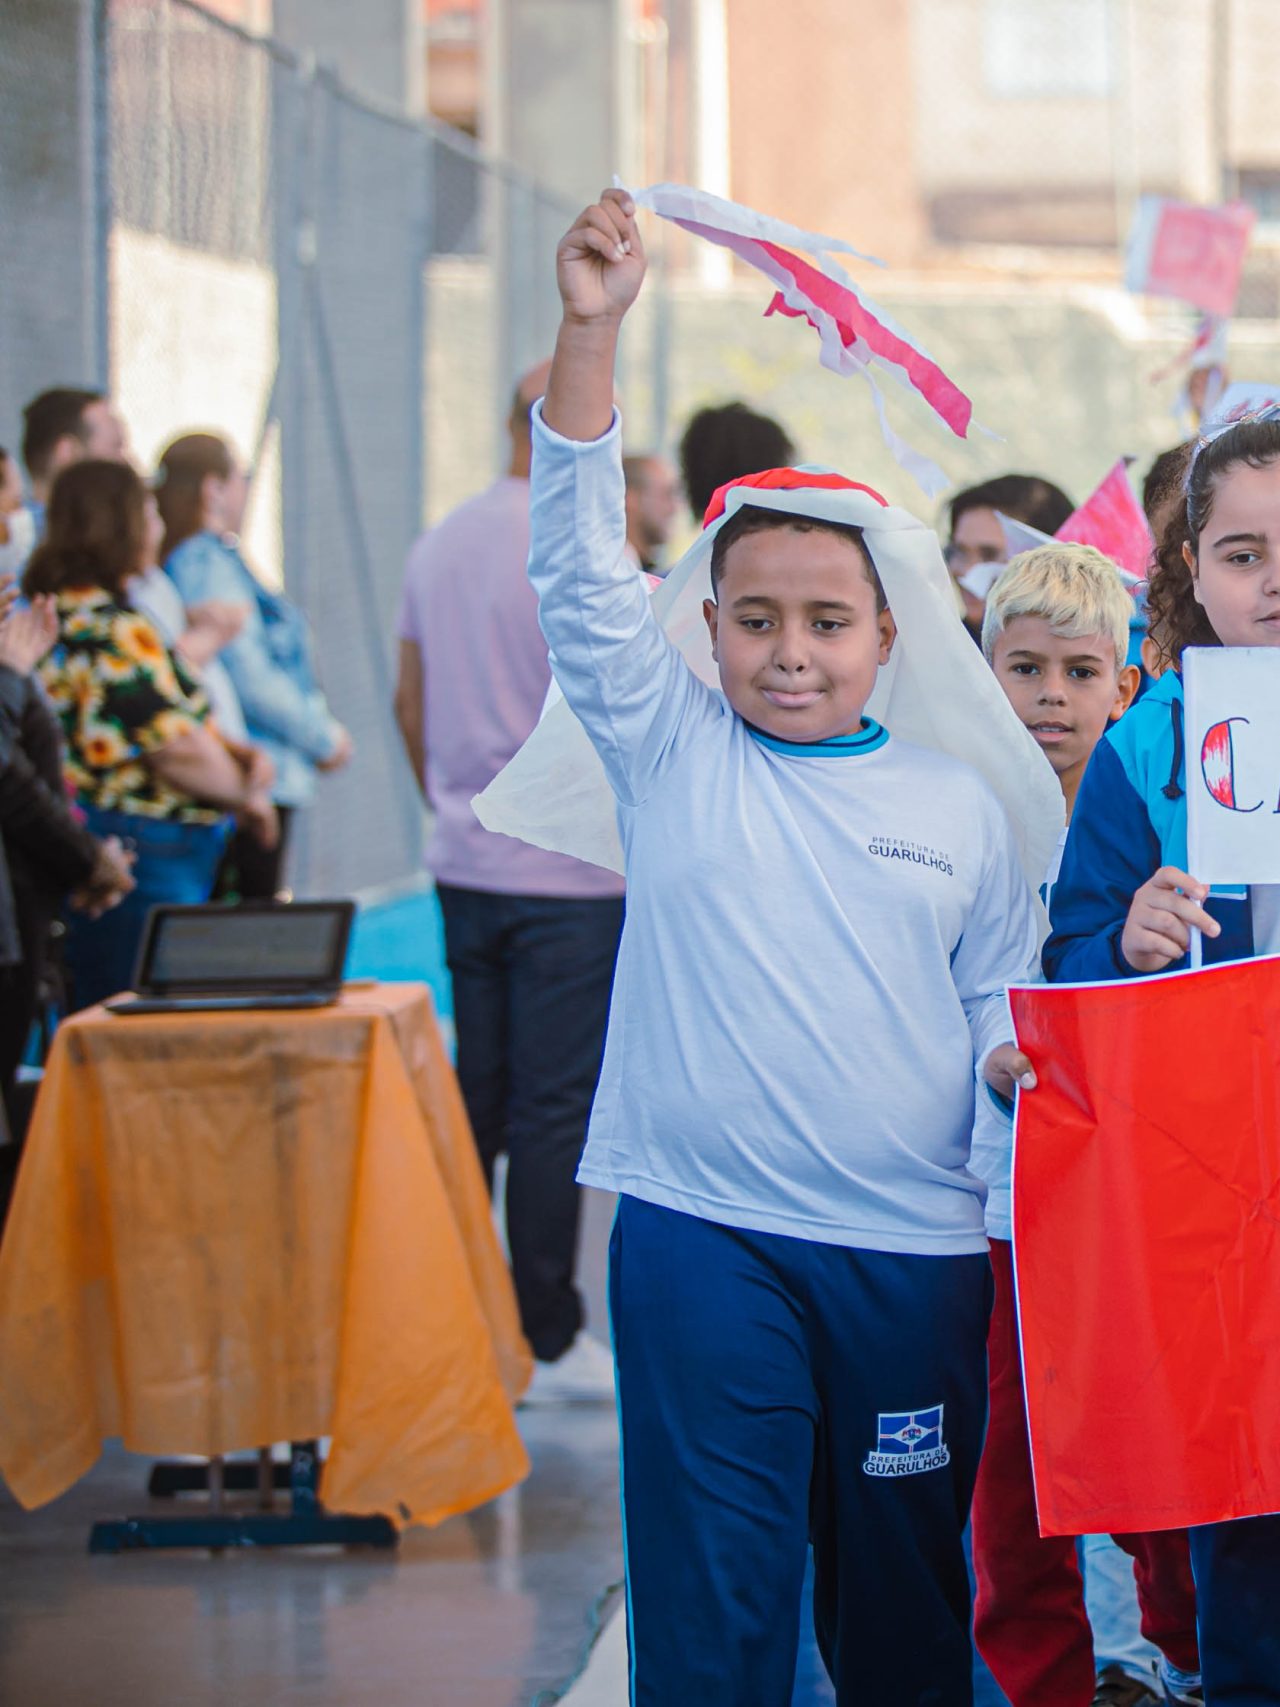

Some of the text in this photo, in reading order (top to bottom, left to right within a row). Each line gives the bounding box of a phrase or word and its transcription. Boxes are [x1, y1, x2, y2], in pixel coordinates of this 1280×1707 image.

[872, 836, 949, 861] PREFEITURA DE
[868, 844, 954, 877] GUARULHOS
[865, 1452, 947, 1474] GUARULHOS
[871, 1446, 945, 1464] PREFEITURA DE
